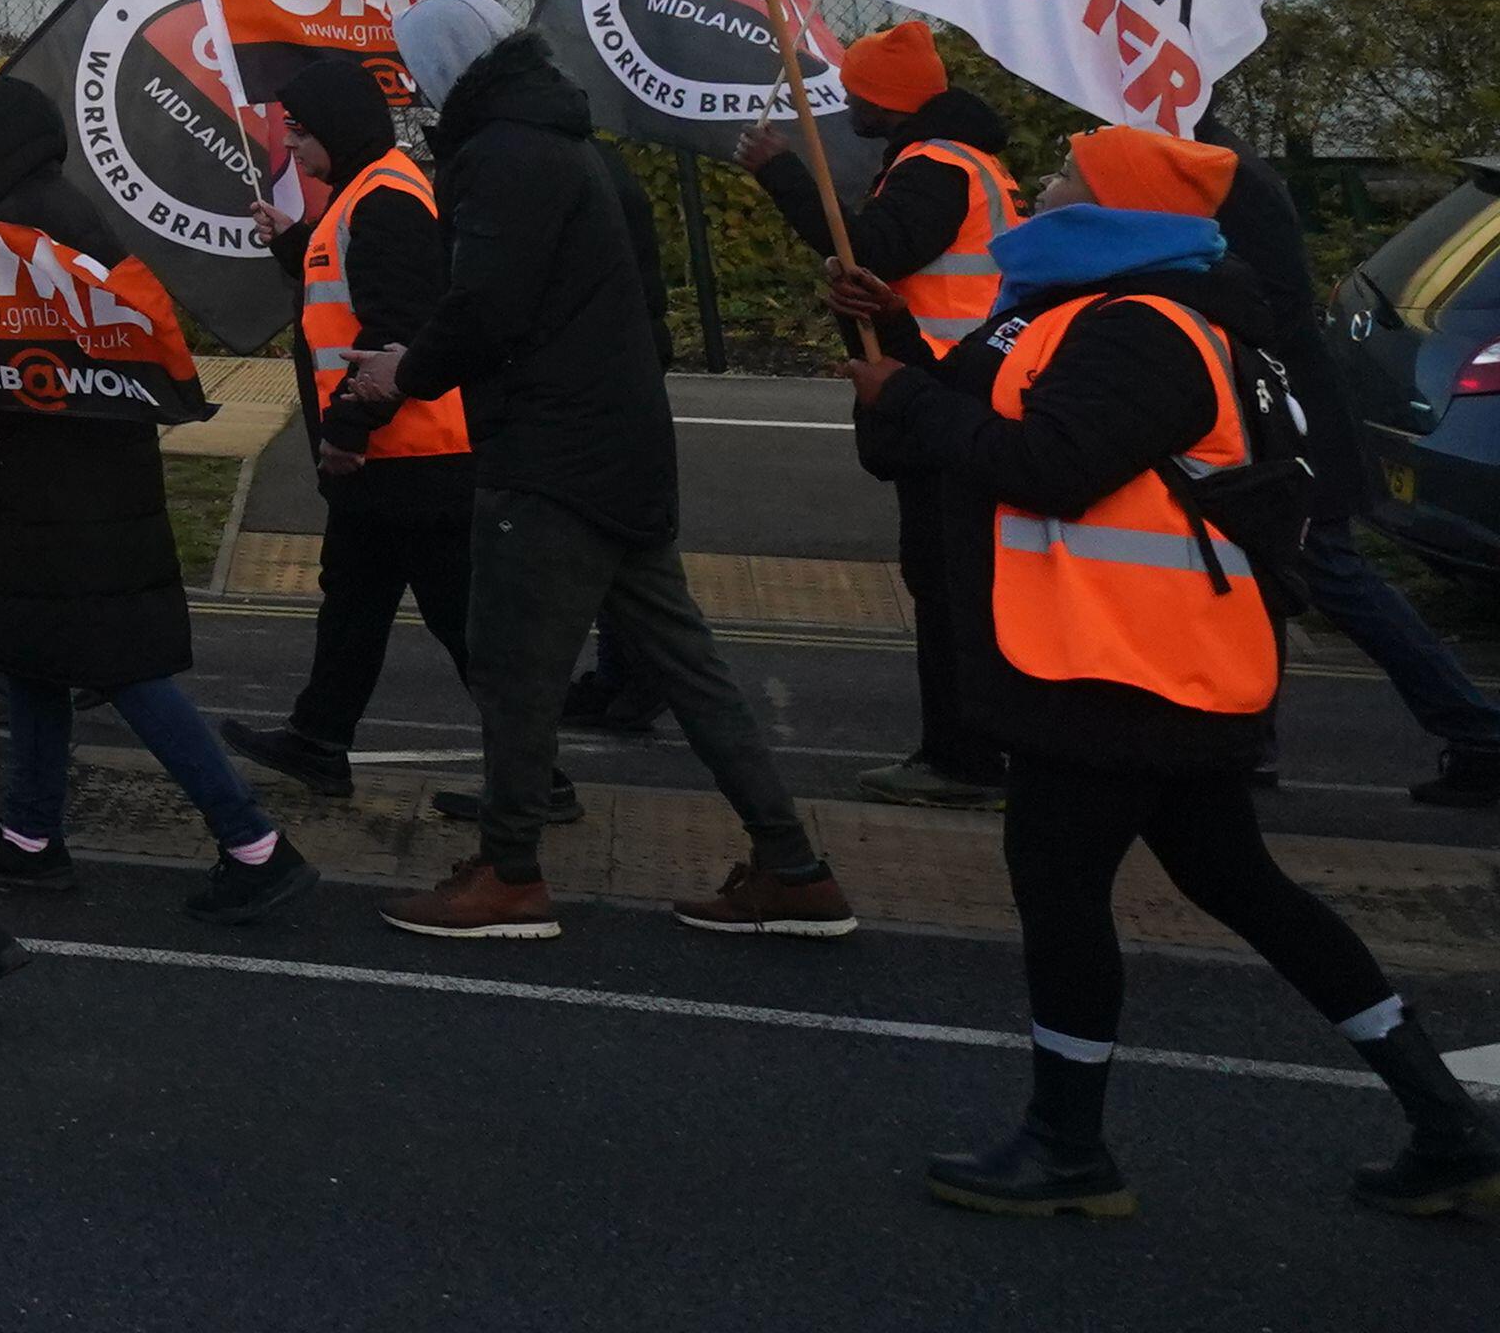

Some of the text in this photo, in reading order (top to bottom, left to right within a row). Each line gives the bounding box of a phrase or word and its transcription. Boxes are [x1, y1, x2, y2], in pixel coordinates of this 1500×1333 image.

[592, 2, 686, 110] WORKERS
[83, 50, 268, 250] WORKERS BRANC
[143, 76, 263, 186] MIDLANDS
